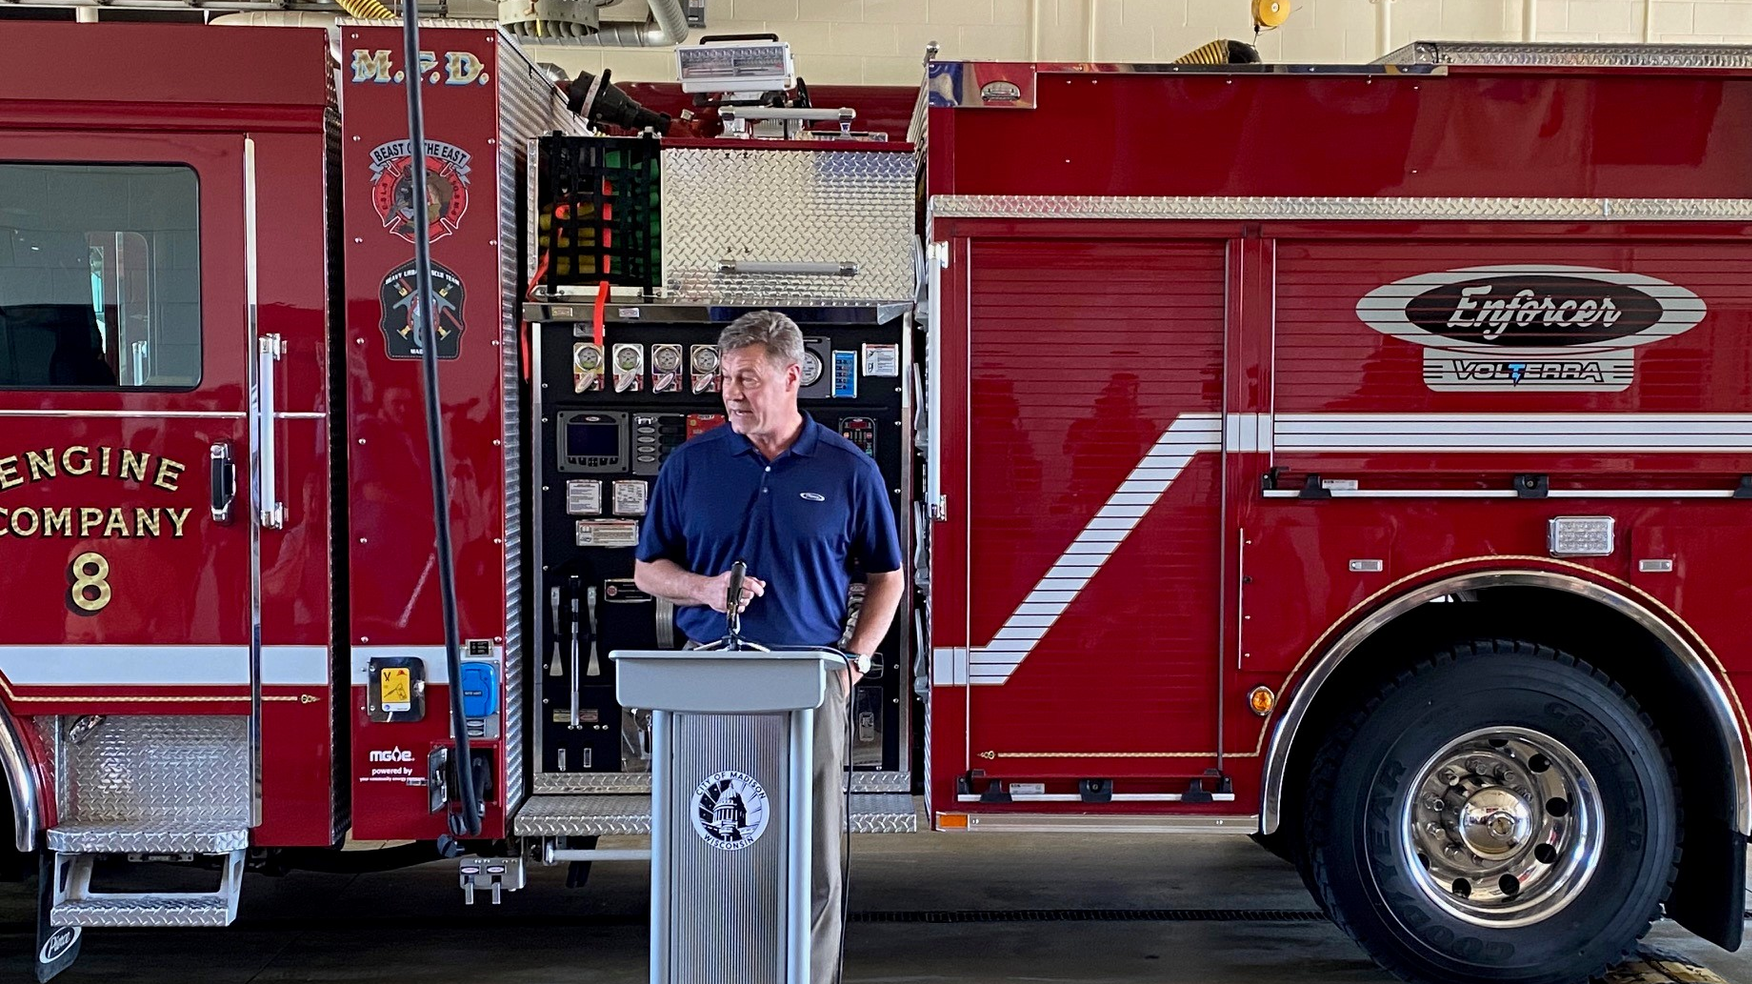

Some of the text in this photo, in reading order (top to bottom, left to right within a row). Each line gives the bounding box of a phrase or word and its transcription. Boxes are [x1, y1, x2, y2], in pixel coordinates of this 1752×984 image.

[373, 143, 404, 163] BEAST
[441, 146, 467, 165] EAST
[1447, 283, 1622, 341] Enforcer
[1452, 359, 1605, 387] VOLTERRA
[0, 445, 187, 492] ENGINE
[69, 551, 113, 613] 8
[371, 767, 413, 776] powered by
[695, 772, 767, 800] CITY OF MADISON
[703, 834, 755, 850] WISCONSIN
[1368, 760, 1516, 960] GOODYEAR
